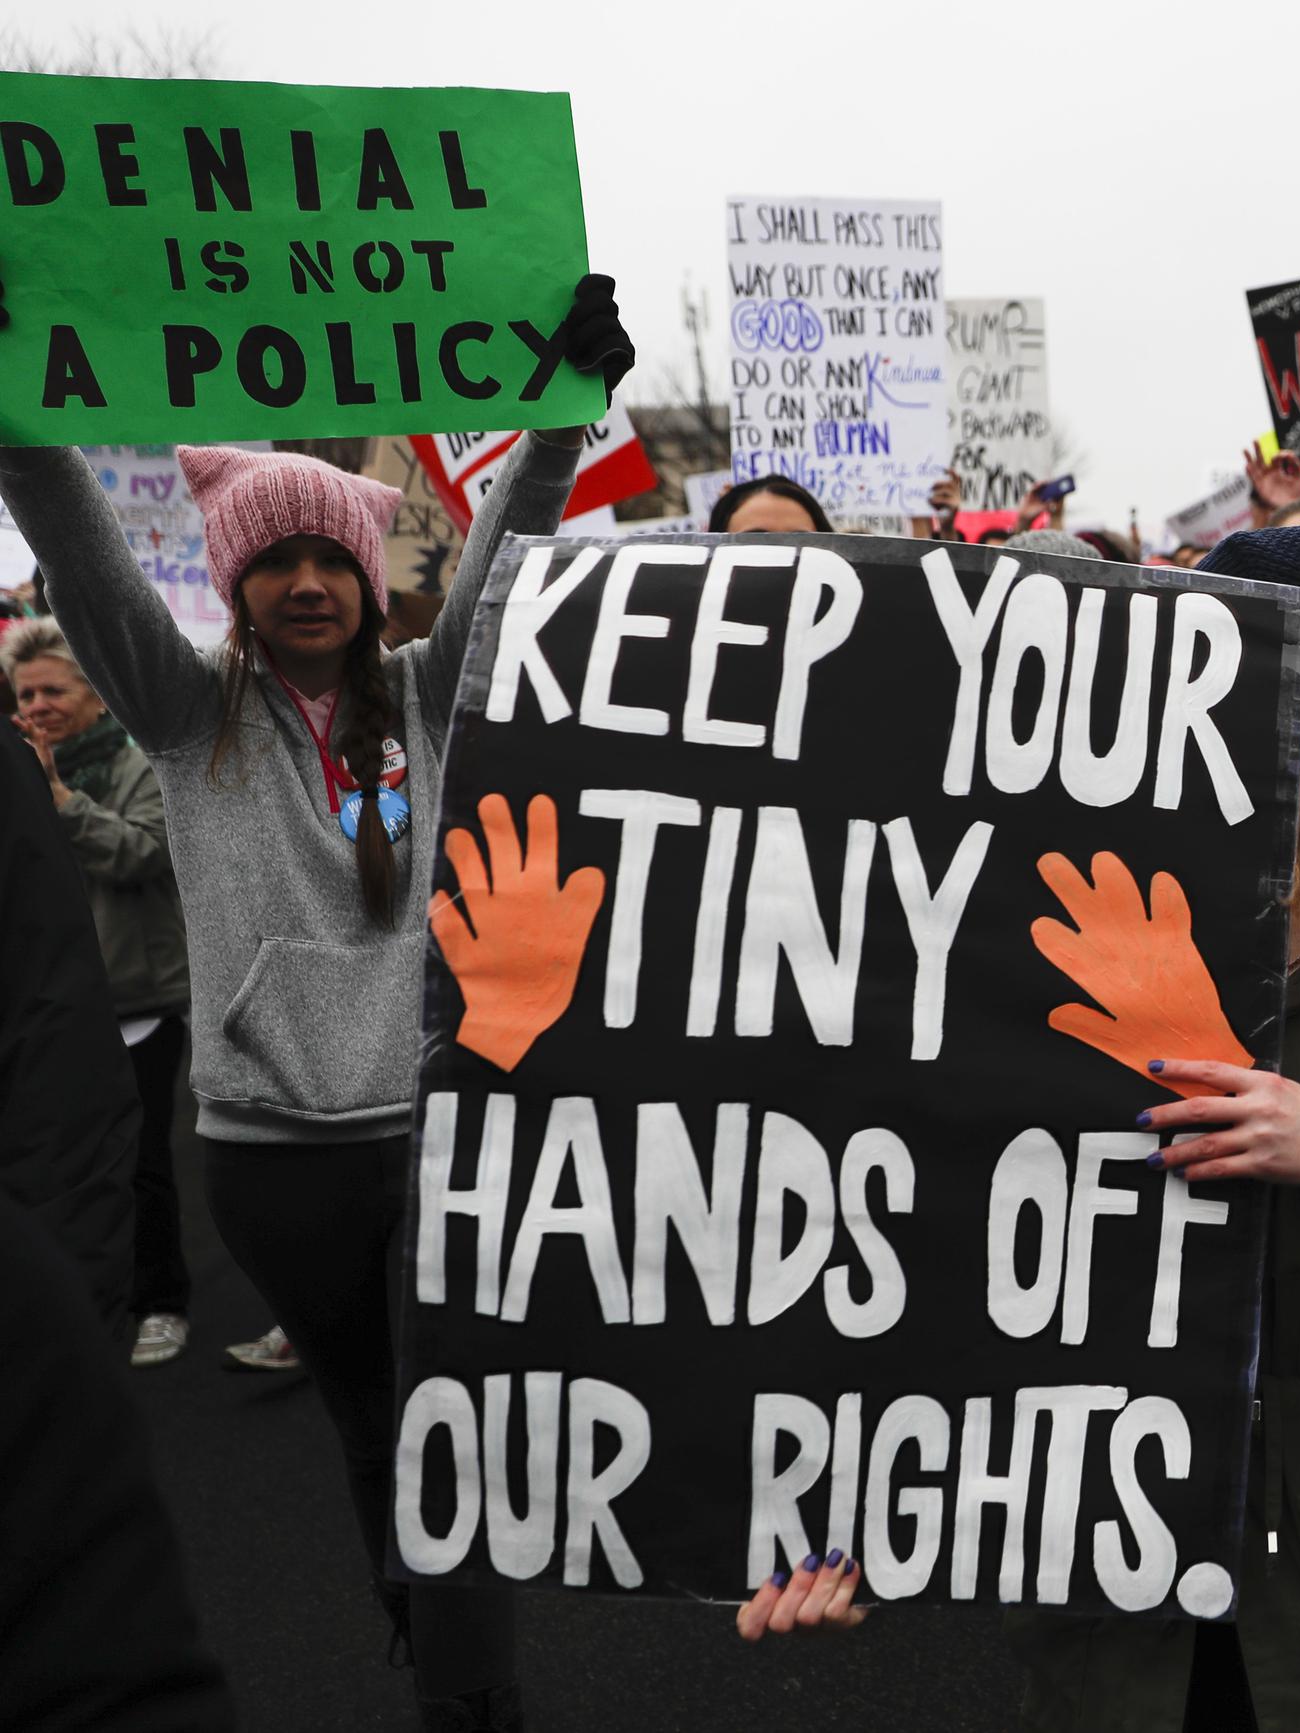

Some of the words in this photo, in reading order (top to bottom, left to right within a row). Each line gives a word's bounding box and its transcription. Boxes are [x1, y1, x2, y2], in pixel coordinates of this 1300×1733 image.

[0, 120, 488, 212] DENIAL
[728, 202, 748, 245] I
[756, 203, 828, 245] SHALL
[833, 211, 885, 248] PASS
[892, 213, 943, 252] THIS
[163, 237, 251, 294] IS
[288, 239, 455, 295] NOT
[728, 261, 777, 298] WAY
[783, 262, 826, 298] BUT
[901, 265, 942, 301] ANY
[730, 297, 824, 353] GOOD
[823, 307, 866, 338] THAT
[873, 307, 888, 337] I
[895, 306, 934, 338] CAN
[41, 324, 108, 408] A
[162, 320, 567, 408] POLICY
[731, 356, 770, 390] DO
[780, 355, 817, 390] OR
[825, 357, 866, 390] ANY
[735, 391, 751, 422] I
[764, 391, 806, 422] CAN
[815, 392, 868, 423] SHOW
[731, 424, 762, 449] TO
[771, 424, 807, 450] ANY
[813, 420, 891, 458] HUMAN
[130, 473, 177, 501] my
[485, 543, 864, 761] KEEP
[920, 546, 1255, 827] YOUR
[578, 788, 995, 1061] TINY
[415, 1091, 916, 1340] HANDS
[987, 1126, 1229, 1349] OFF
[394, 1370, 652, 1589] OUR
[746, 1385, 1234, 1618] RIGHTS.
